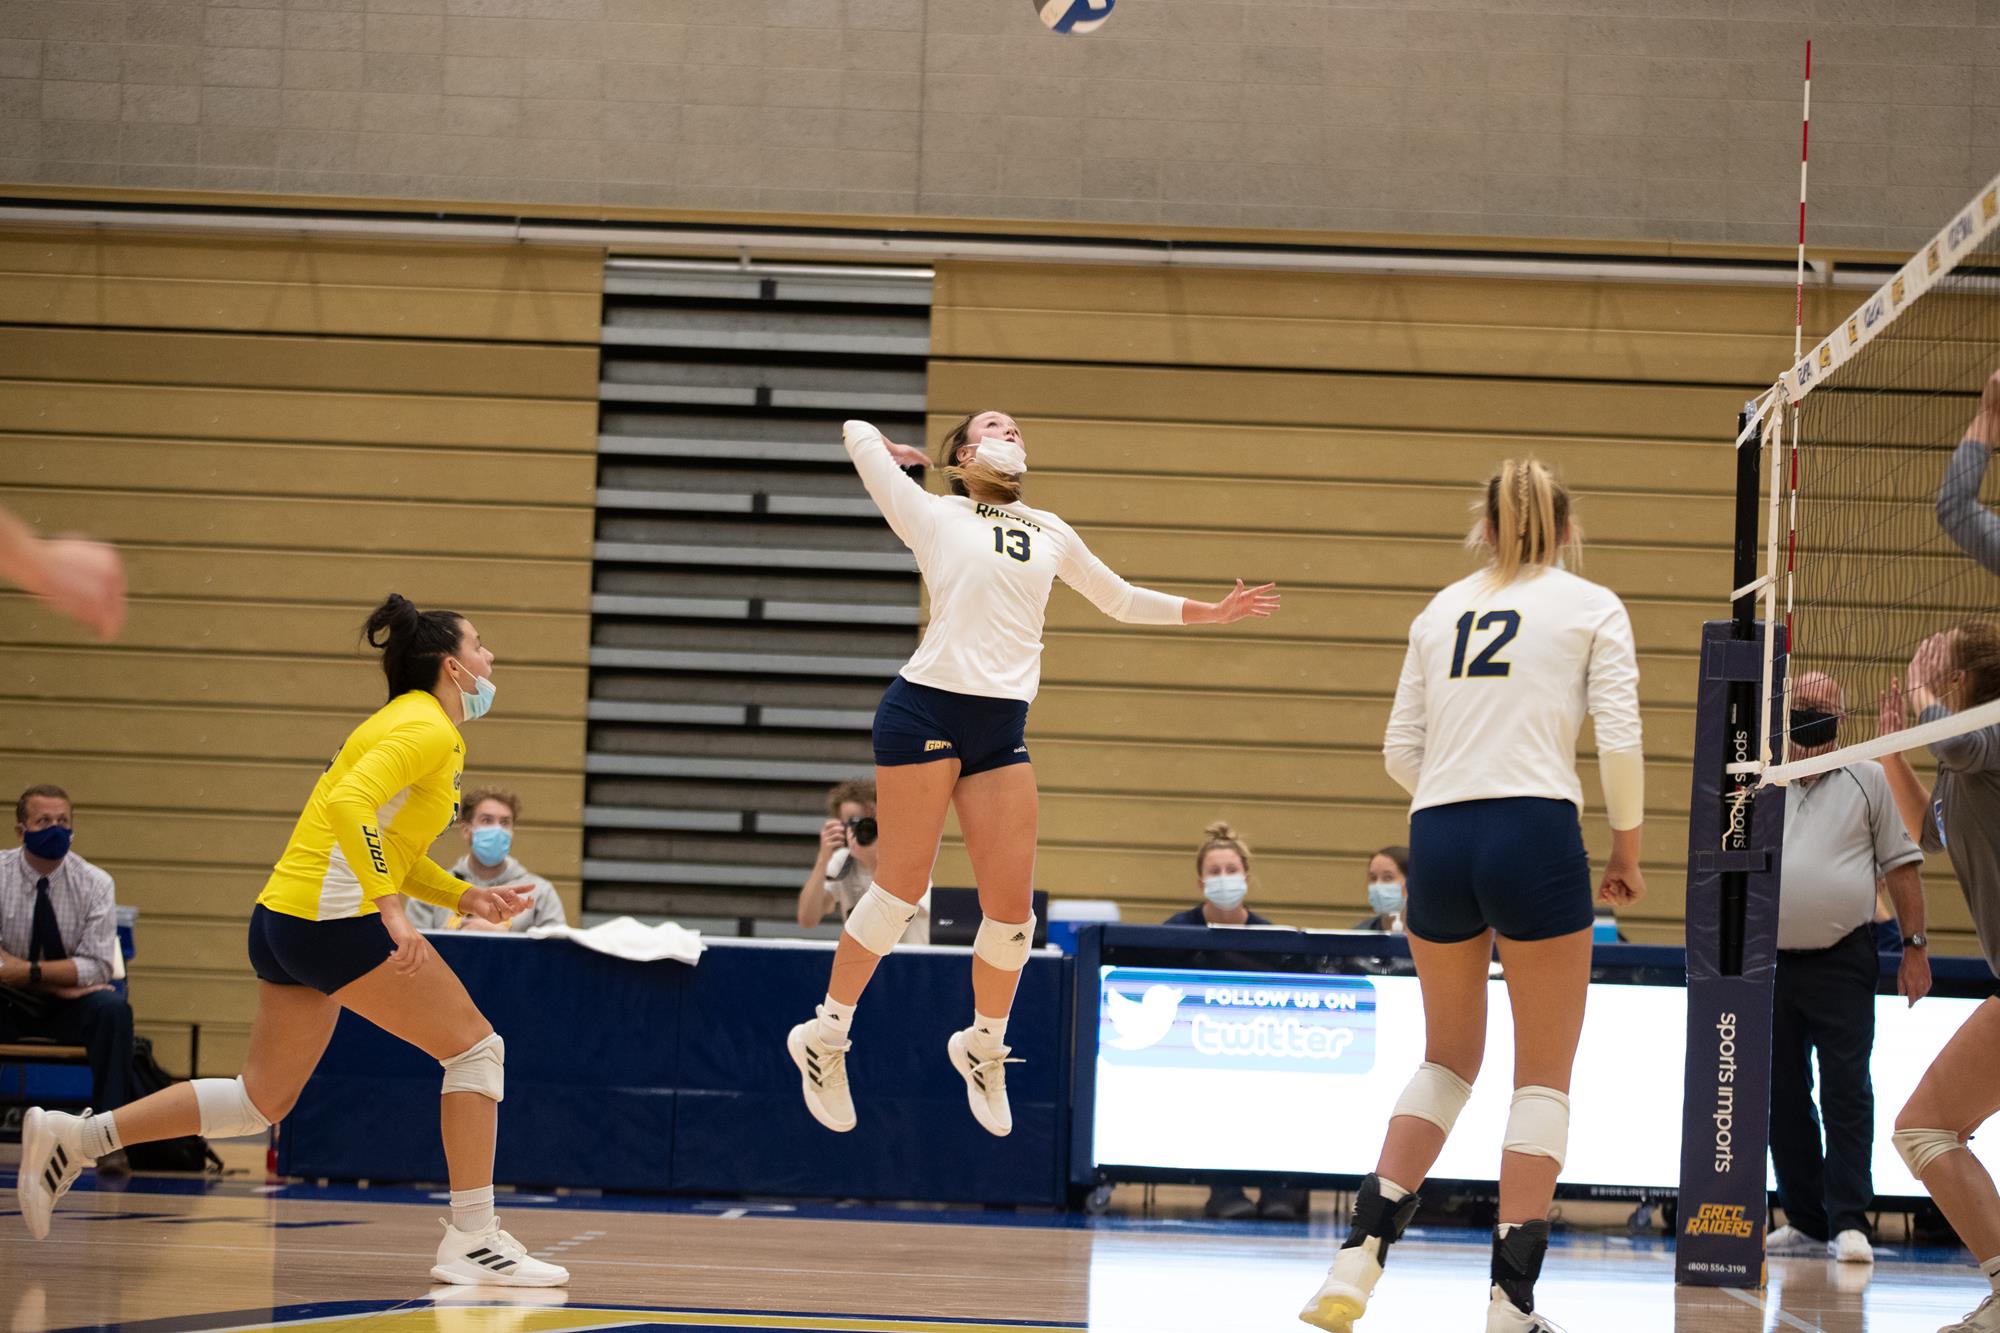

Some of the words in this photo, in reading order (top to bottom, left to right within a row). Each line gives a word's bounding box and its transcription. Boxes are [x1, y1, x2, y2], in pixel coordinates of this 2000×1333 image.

[992, 525, 1031, 563] 13
[1449, 609, 1522, 679] 12
[1732, 730, 1748, 783] spos
[361, 825, 389, 875] GRCC
[1204, 988, 1292, 1008] FOLLOW
[1294, 991, 1320, 1009] US
[1324, 992, 1357, 1010] ON
[1191, 1013, 1355, 1060] twitter
[1715, 1012, 1737, 1083] sports
[1712, 1086, 1734, 1173] imports
[1685, 1217, 1754, 1238] RAIDERS
[1697, 1203, 1746, 1221] GRCC
[1688, 1262, 1709, 1272] (800)
